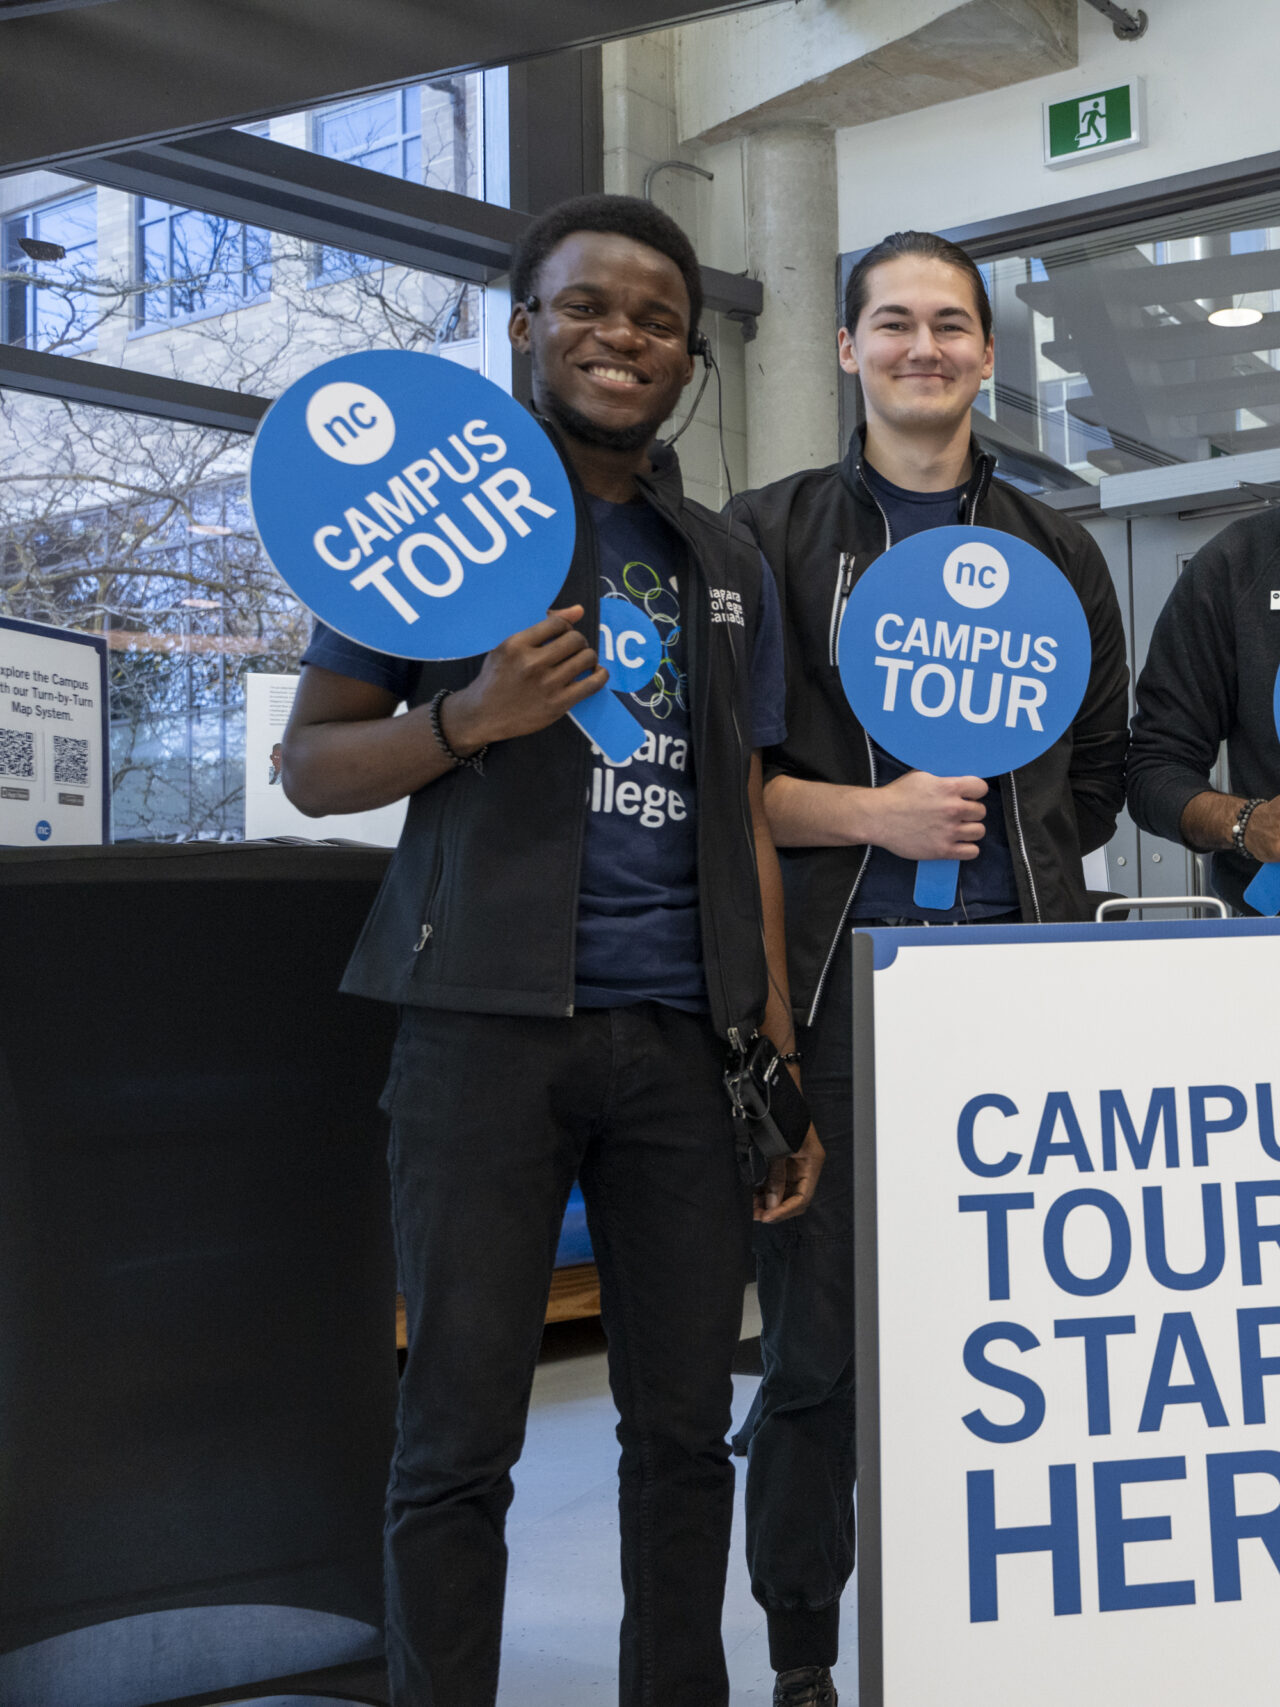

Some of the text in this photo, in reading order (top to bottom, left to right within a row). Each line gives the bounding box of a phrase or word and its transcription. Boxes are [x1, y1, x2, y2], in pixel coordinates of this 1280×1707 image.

[324, 402, 377, 447] nc
[313, 419, 507, 571] CAMPUS
[350, 467, 557, 625] TOUR
[956, 561, 997, 589] nc
[708, 586, 742, 602] iagara
[875, 613, 1058, 673] CAMPUS
[0, 666, 89, 690] xplore the Campus
[874, 655, 1047, 732] TOUR
[11, 700, 74, 722] Map System.
[13, 686, 28, 697] our
[32, 686, 94, 708] Turn-by-Turn
